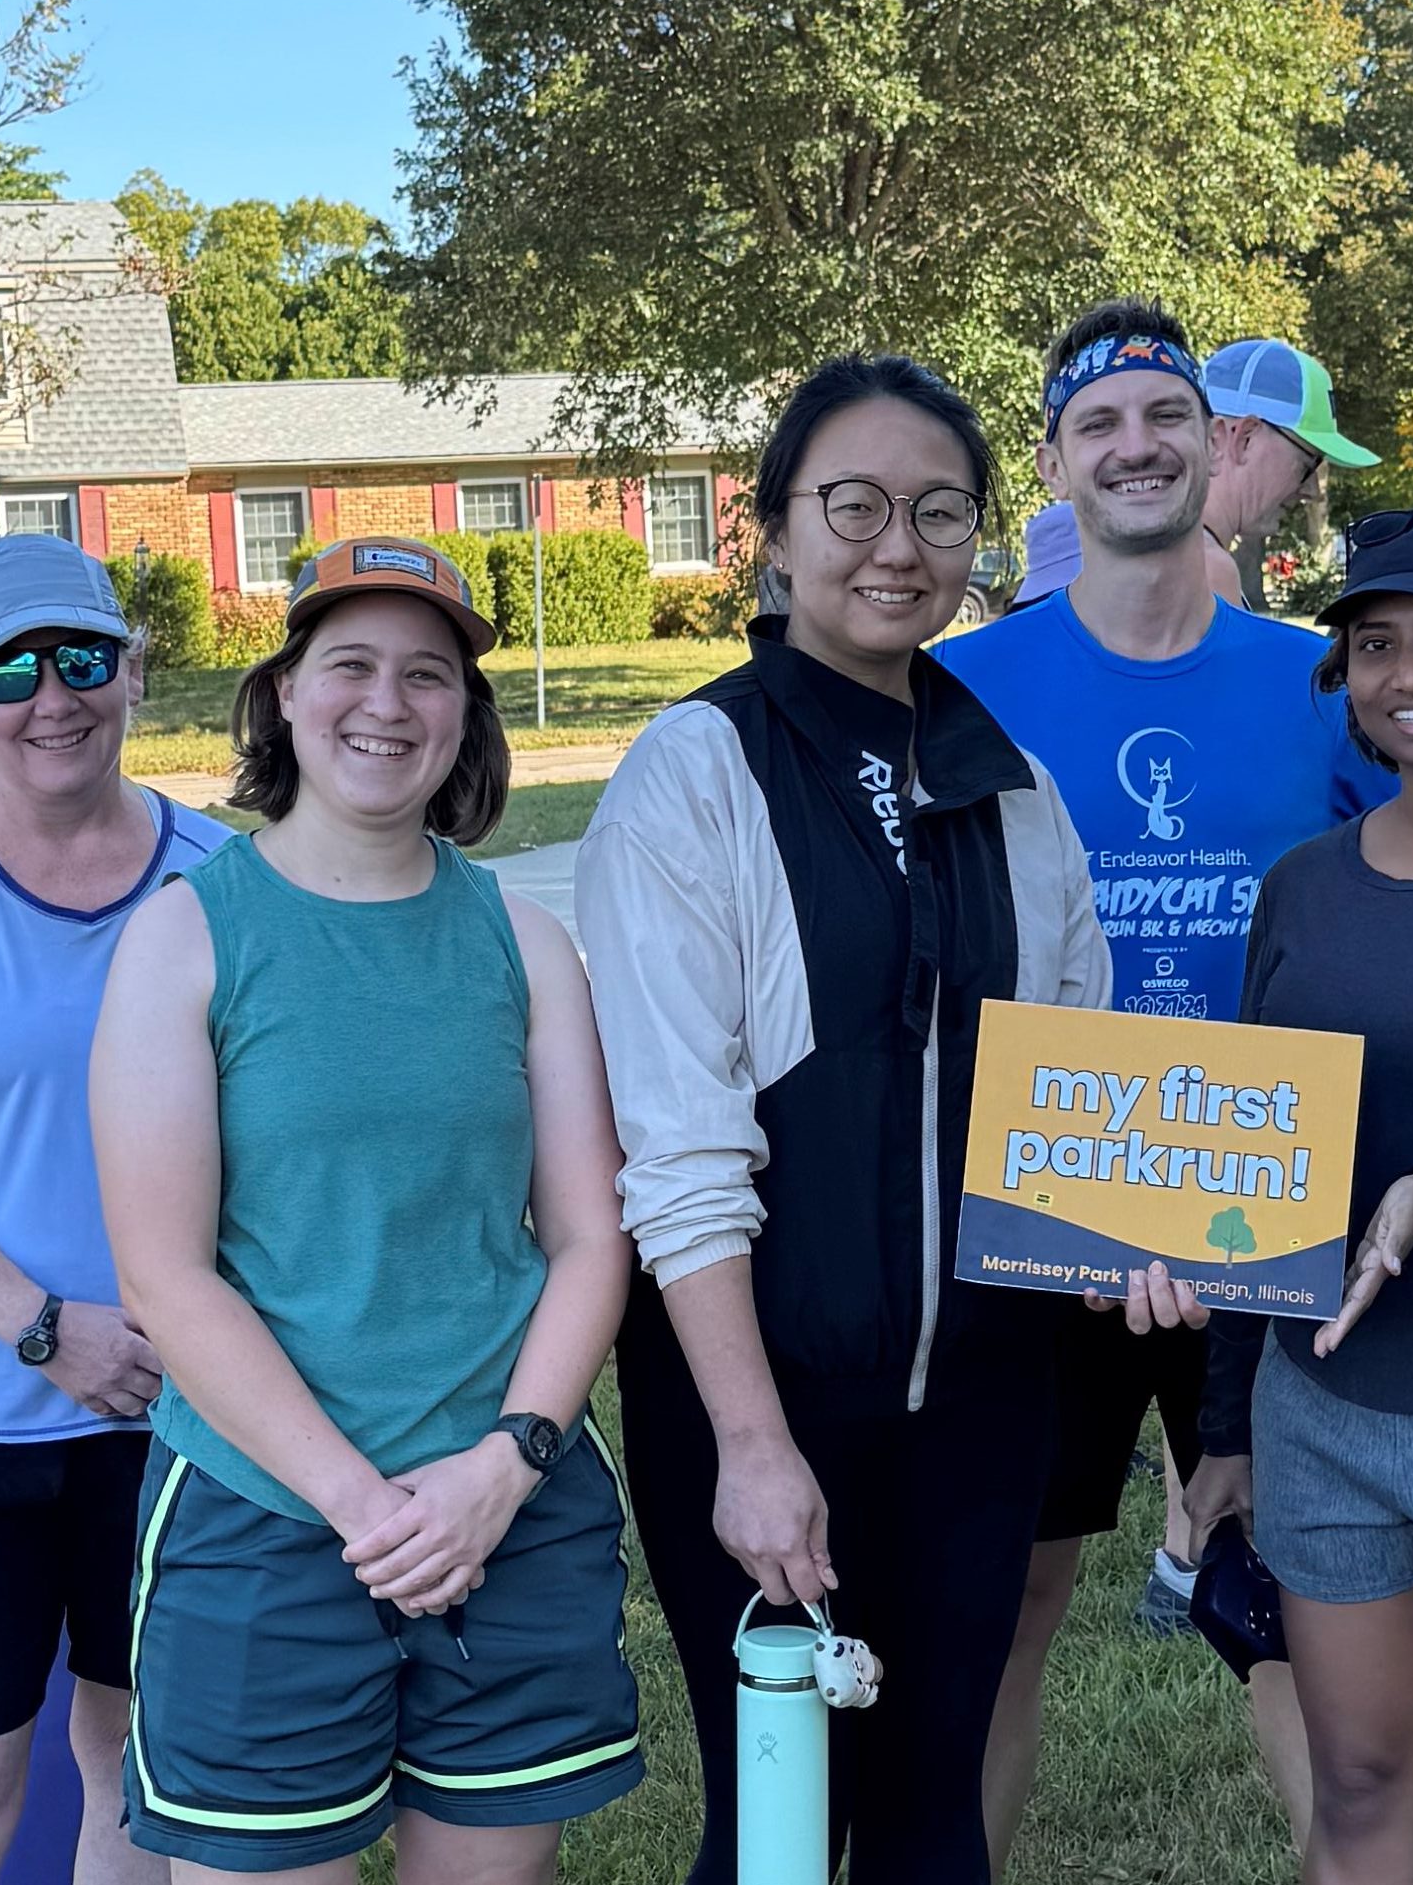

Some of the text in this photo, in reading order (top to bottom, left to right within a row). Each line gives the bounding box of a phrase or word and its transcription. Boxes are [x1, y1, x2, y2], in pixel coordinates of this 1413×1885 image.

[1100, 850, 1188, 868] Endeavor
[1032, 1065, 1300, 1133] my first
[1003, 1129, 1311, 1202] parkrun!
[982, 1254, 1075, 1281] Morrissey
[1079, 1264, 1122, 1285] Park
[1258, 1283, 1315, 1306] Illinois
